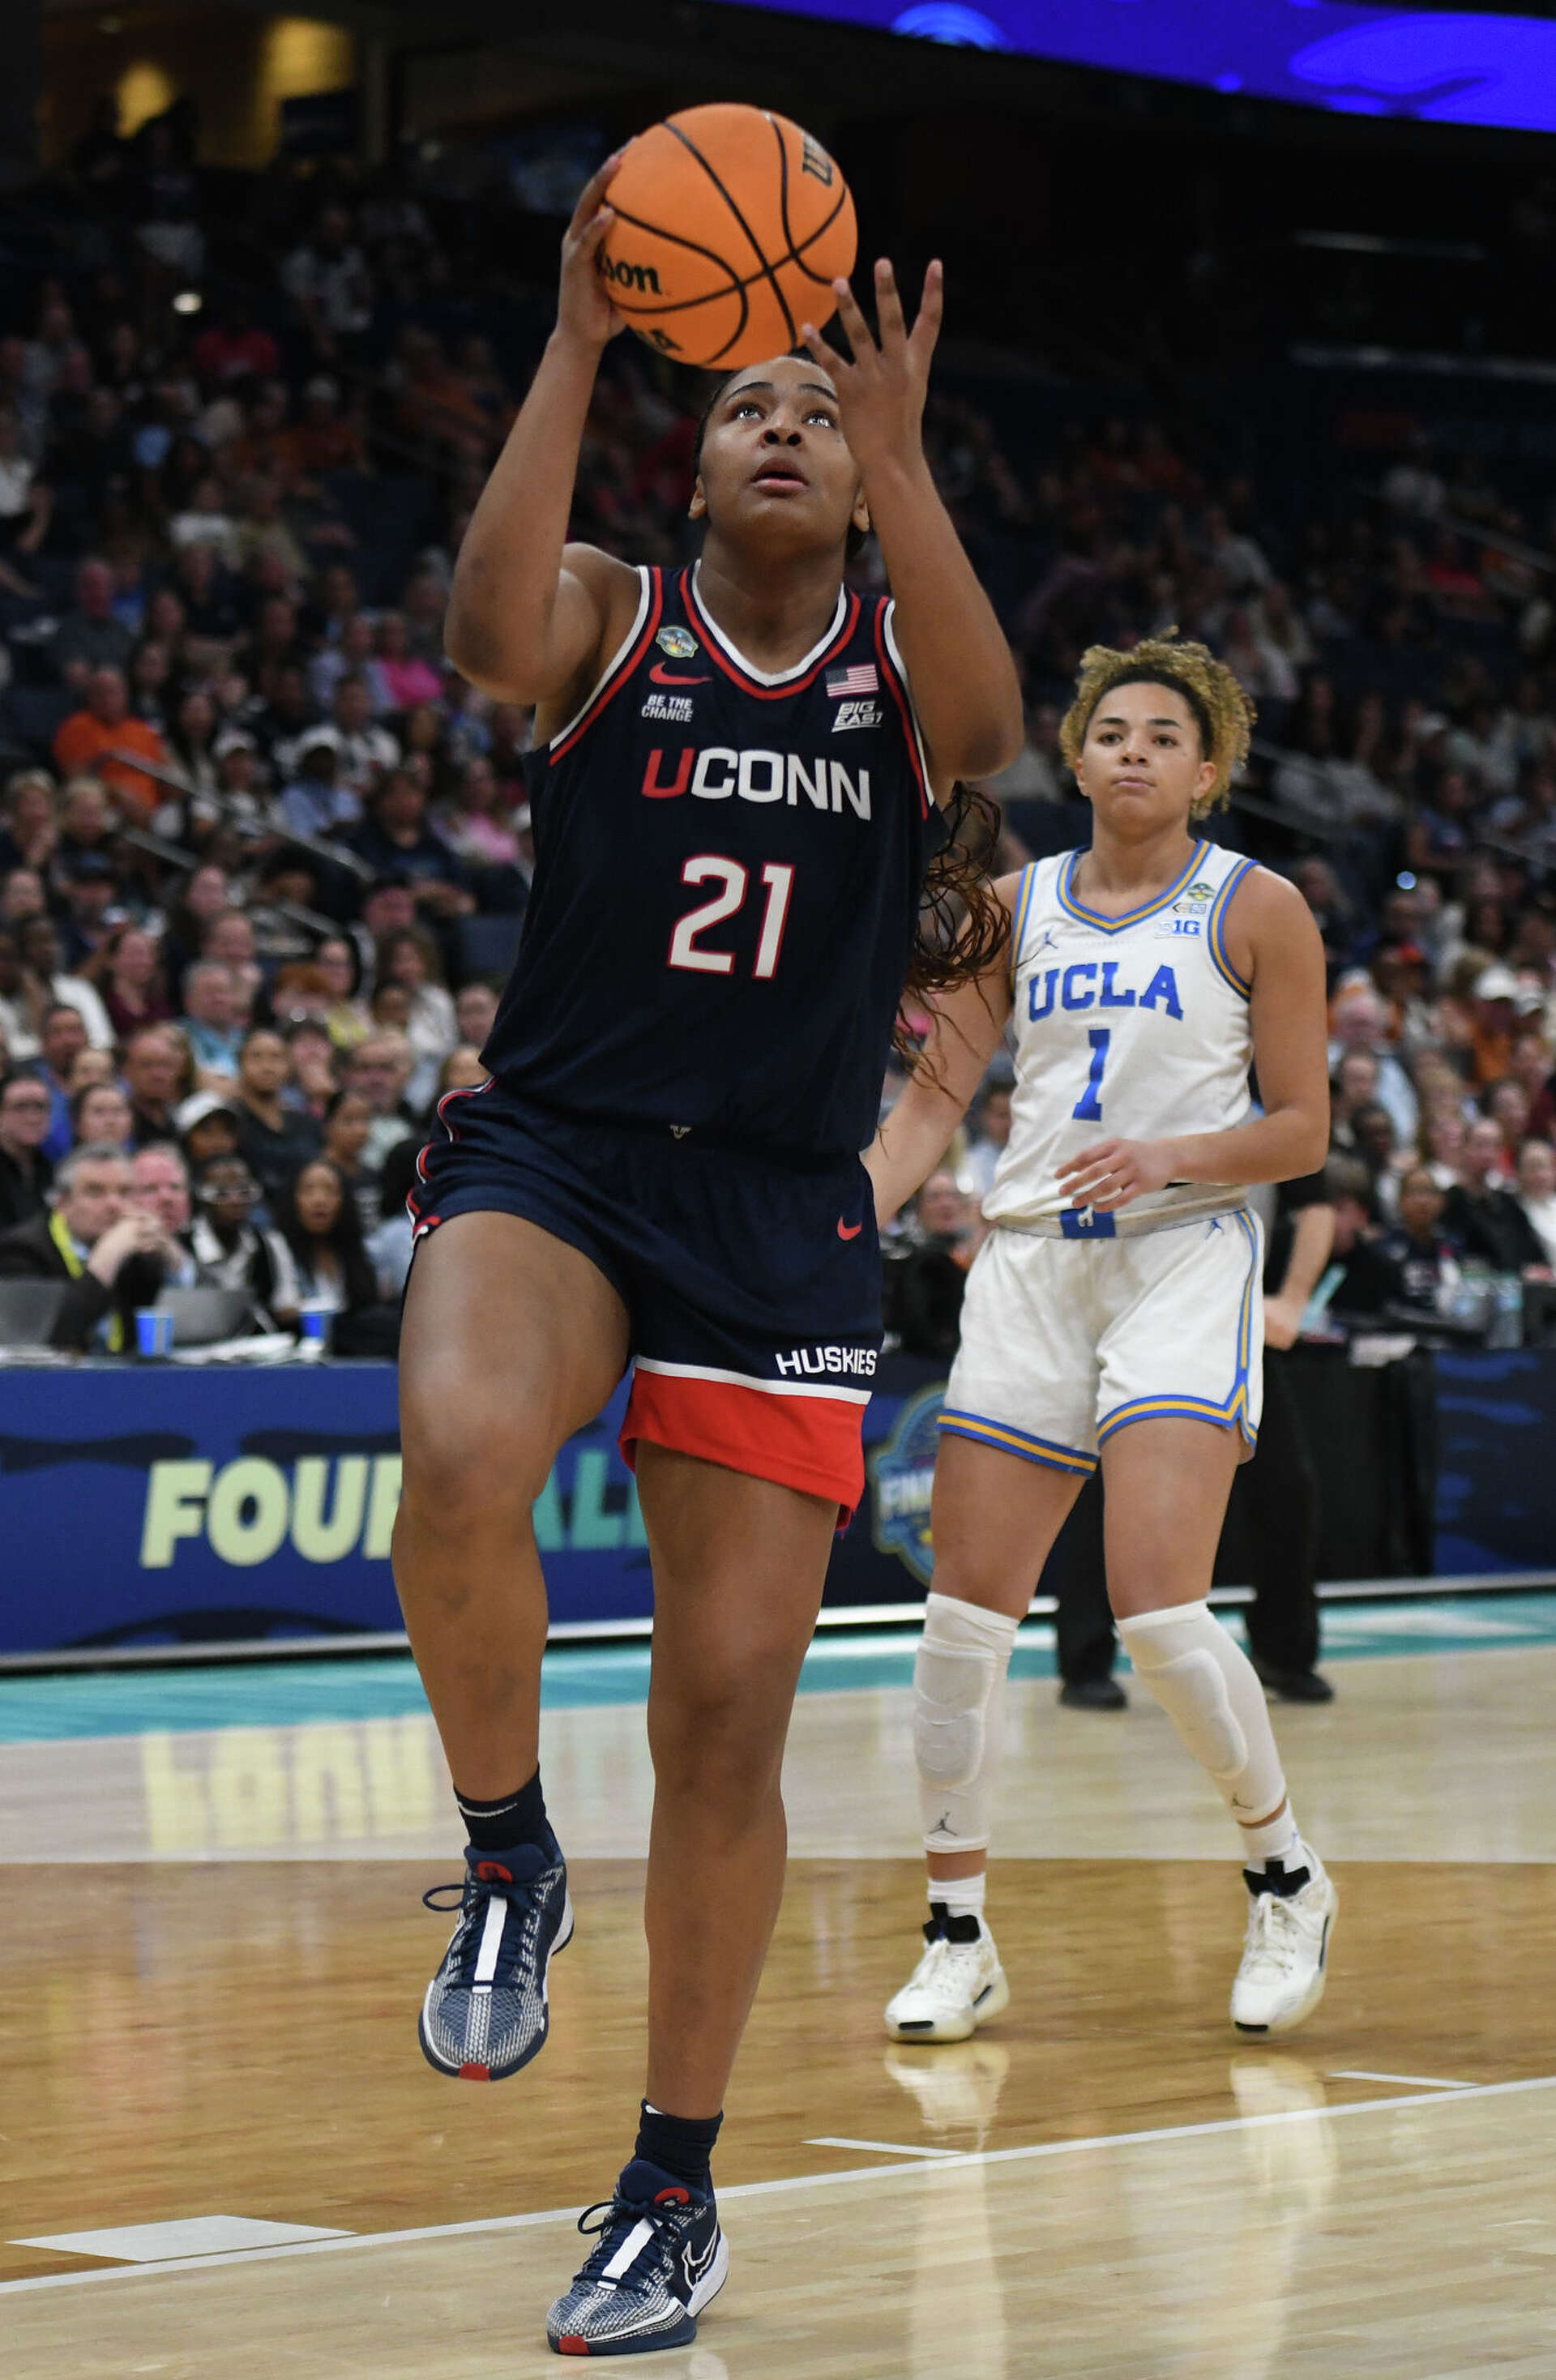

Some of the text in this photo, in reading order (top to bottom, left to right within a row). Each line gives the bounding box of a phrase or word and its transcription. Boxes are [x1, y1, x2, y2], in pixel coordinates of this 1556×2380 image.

[641, 705, 694, 723] CHANGE
[648, 694, 694, 710] BE THE
[838, 699, 876, 713] BIG
[641, 746, 872, 821] UCONN
[666, 852, 797, 981] 21
[1028, 961, 1184, 1023] UCLA
[1071, 1028, 1111, 1122] 1
[775, 1346, 878, 1377] HUSKIES
